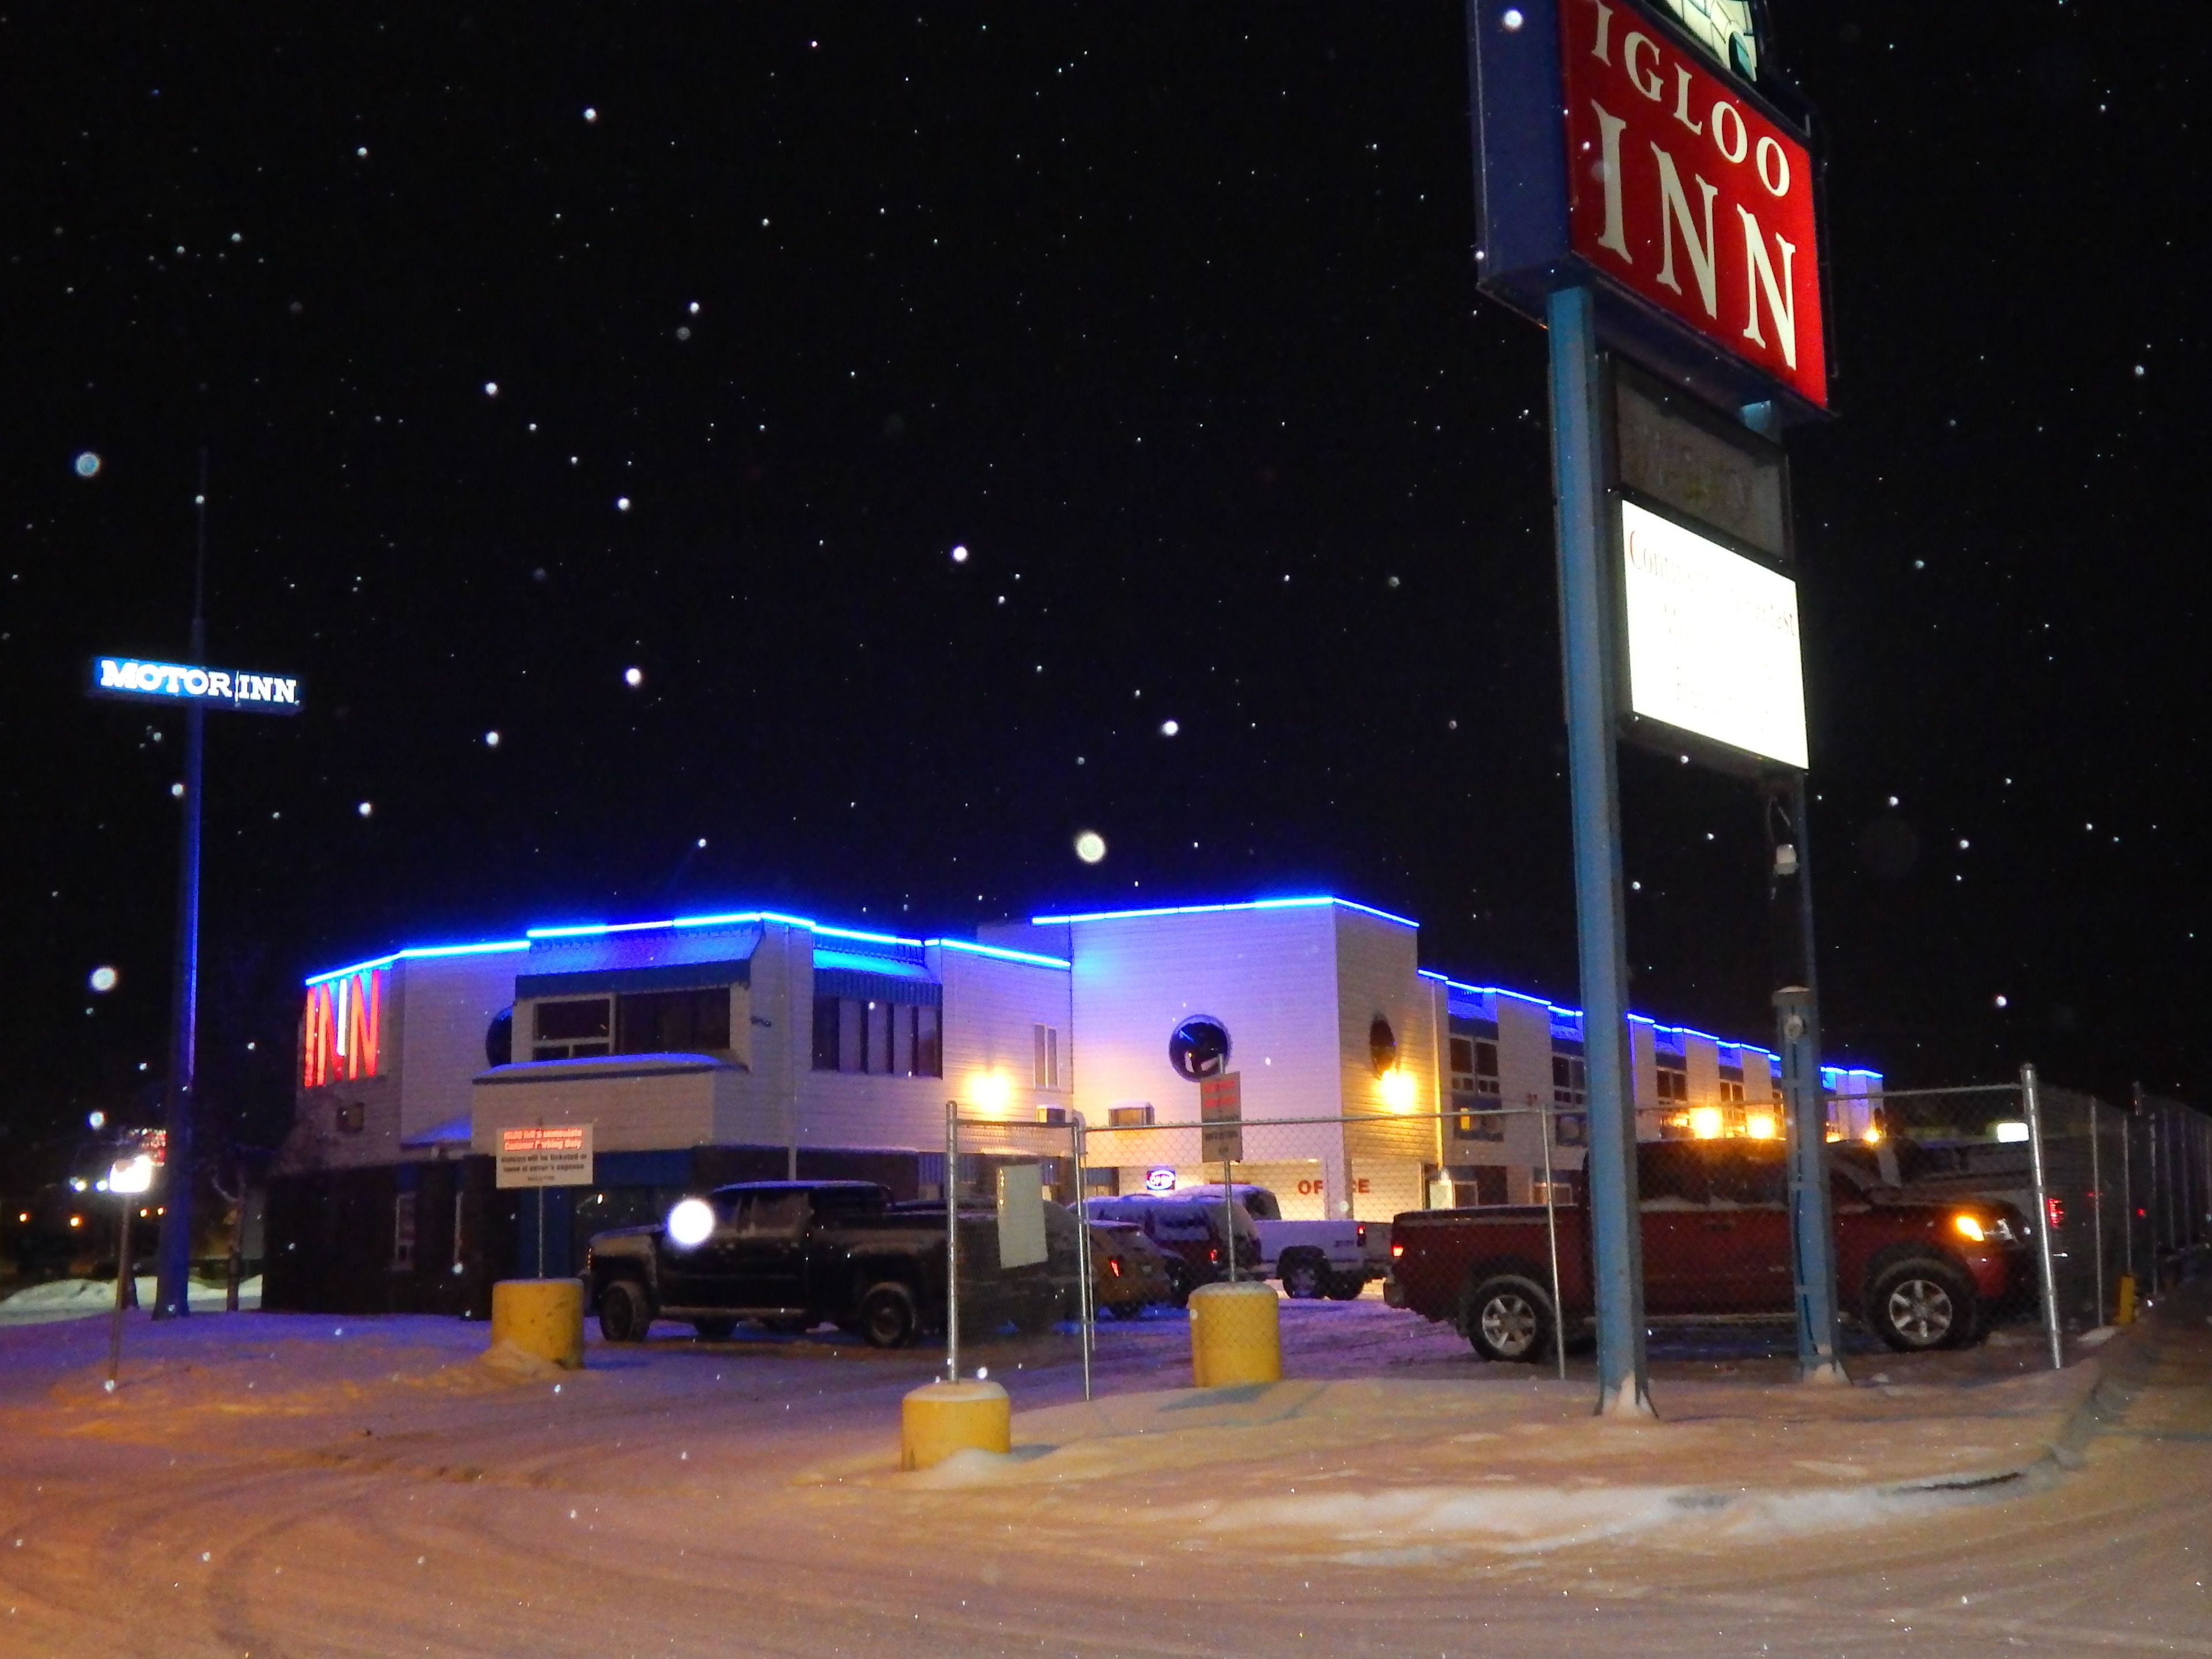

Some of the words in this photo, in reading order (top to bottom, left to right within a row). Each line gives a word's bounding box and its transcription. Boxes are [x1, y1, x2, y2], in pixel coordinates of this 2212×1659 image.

[1591, 0, 1790, 197] IGLOO
[1591, 99, 1797, 371] INN
[100, 660, 232, 698] MOTOR
[239, 675, 297, 703] INN
[1298, 1178, 1370, 1195] OFE
